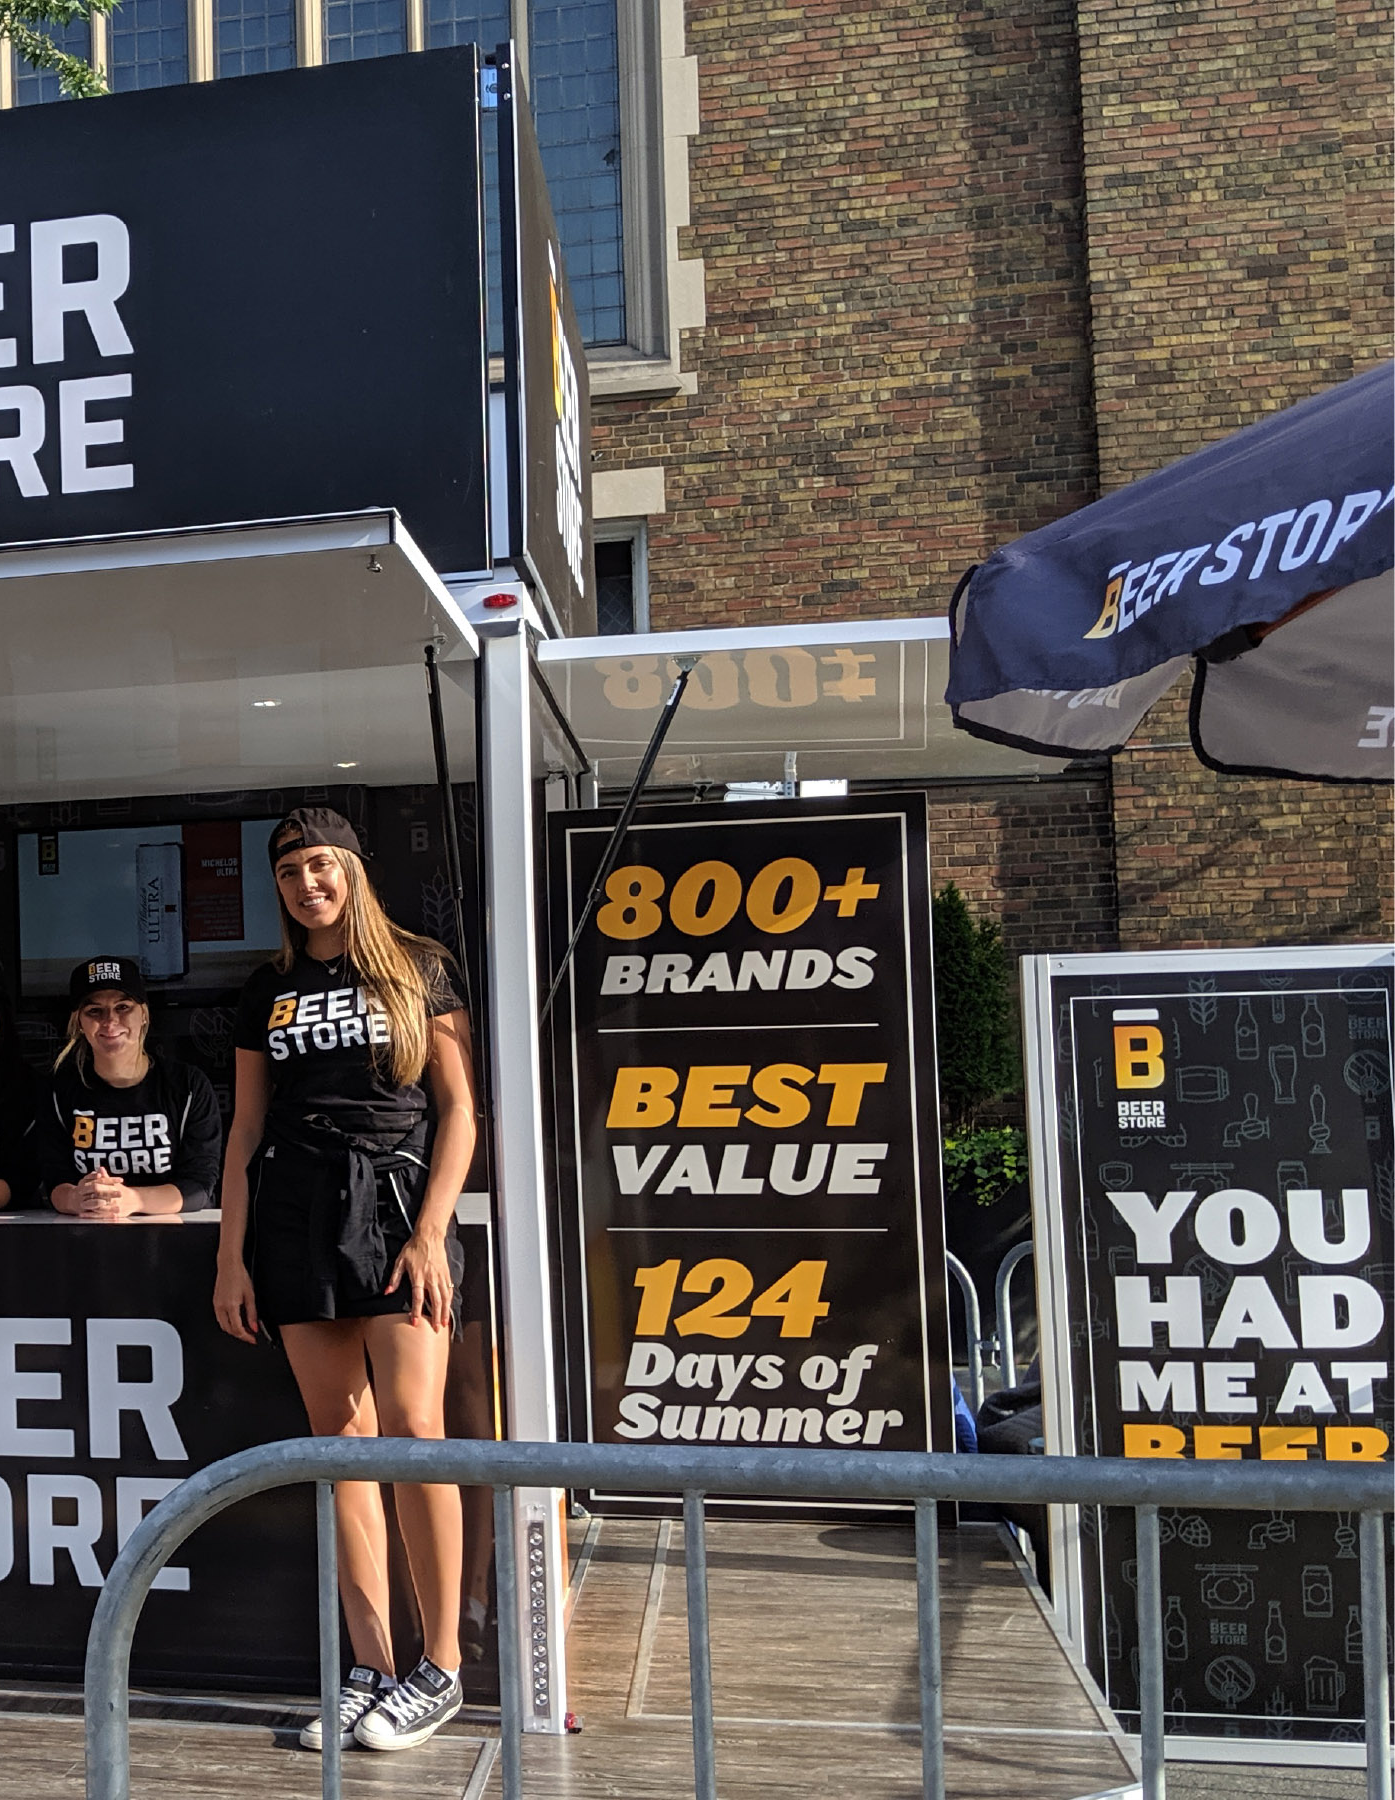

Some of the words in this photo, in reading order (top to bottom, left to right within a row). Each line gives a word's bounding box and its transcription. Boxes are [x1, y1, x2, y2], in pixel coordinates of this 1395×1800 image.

[549, 274, 583, 494] BEER
[1083, 543, 1212, 641] BEER
[1199, 484, 1394, 586] STOR
[147, 877, 161, 943] ULTRA
[596, 857, 880, 940] 800+
[88, 962, 121, 975] BEER
[88, 972, 122, 983] STORE
[600, 946, 877, 996] BRANDS
[268, 1013, 391, 1061] STORE
[1113, 1024, 1166, 1090] B
[606, 1063, 888, 1129] BEST
[1117, 1101, 1166, 1117] BEER
[1118, 1117, 1167, 1129] STORE
[72, 1112, 172, 1150] BEER
[73, 1146, 172, 1175] STORE
[611, 1143, 889, 1196] VALUE
[1106, 1188, 1372, 1265] YOU
[633, 1258, 830, 1339] 124
[1114, 1275, 1385, 1350] HAD
[624, 1342, 783, 1402] Days
[800, 1344, 879, 1406] of
[1118, 1361, 1257, 1414] ME
[1275, 1361, 1389, 1415] AT
[613, 1391, 903, 1446] Summer
[1209, 1621, 1248, 1635] BEER
[1210, 1635, 1249, 1646] STORE
